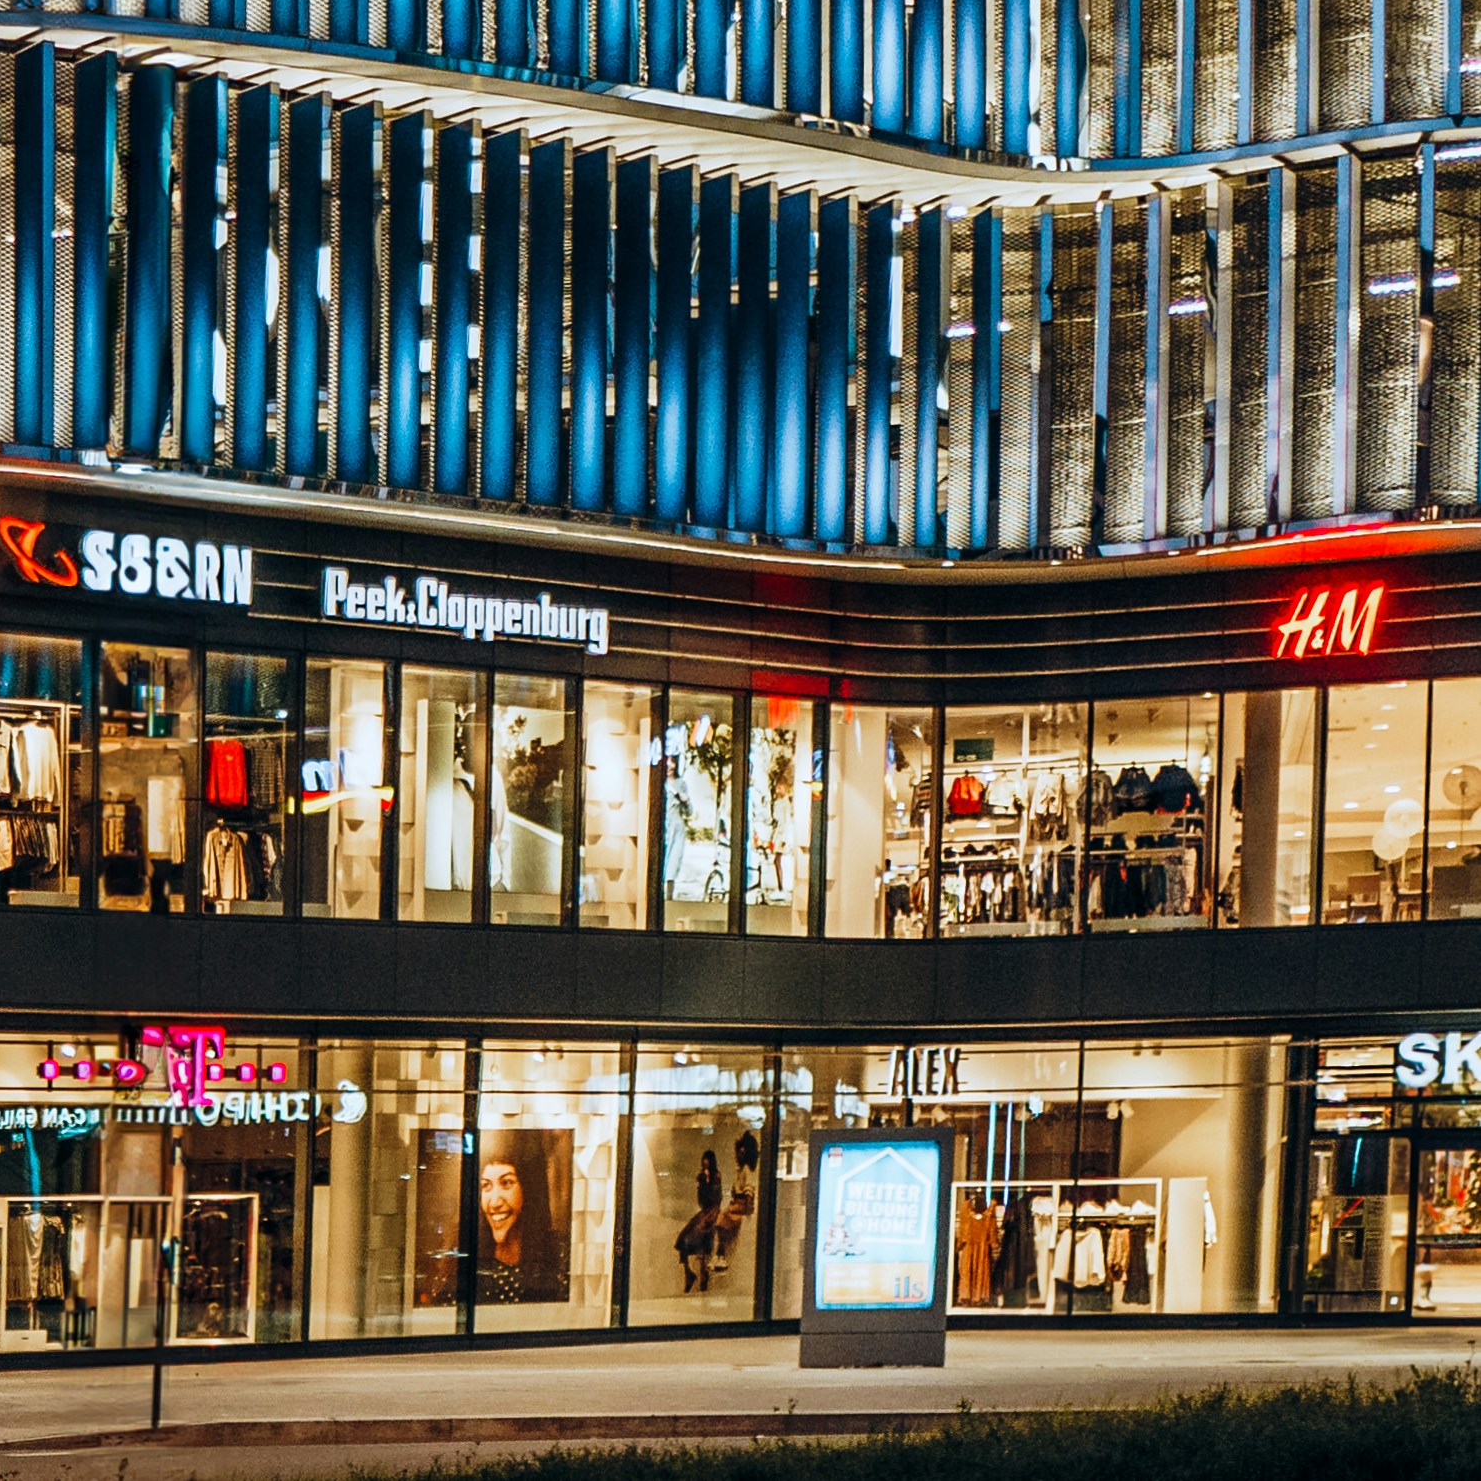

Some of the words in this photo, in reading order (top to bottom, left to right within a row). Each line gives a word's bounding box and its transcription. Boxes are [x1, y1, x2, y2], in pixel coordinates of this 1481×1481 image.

[1274, 582, 1385, 659] H&M
[847, 1181, 922, 1202] WEITER
[845, 1200, 920, 1217] BILDUNG
[892, 1275, 925, 1300] ils
